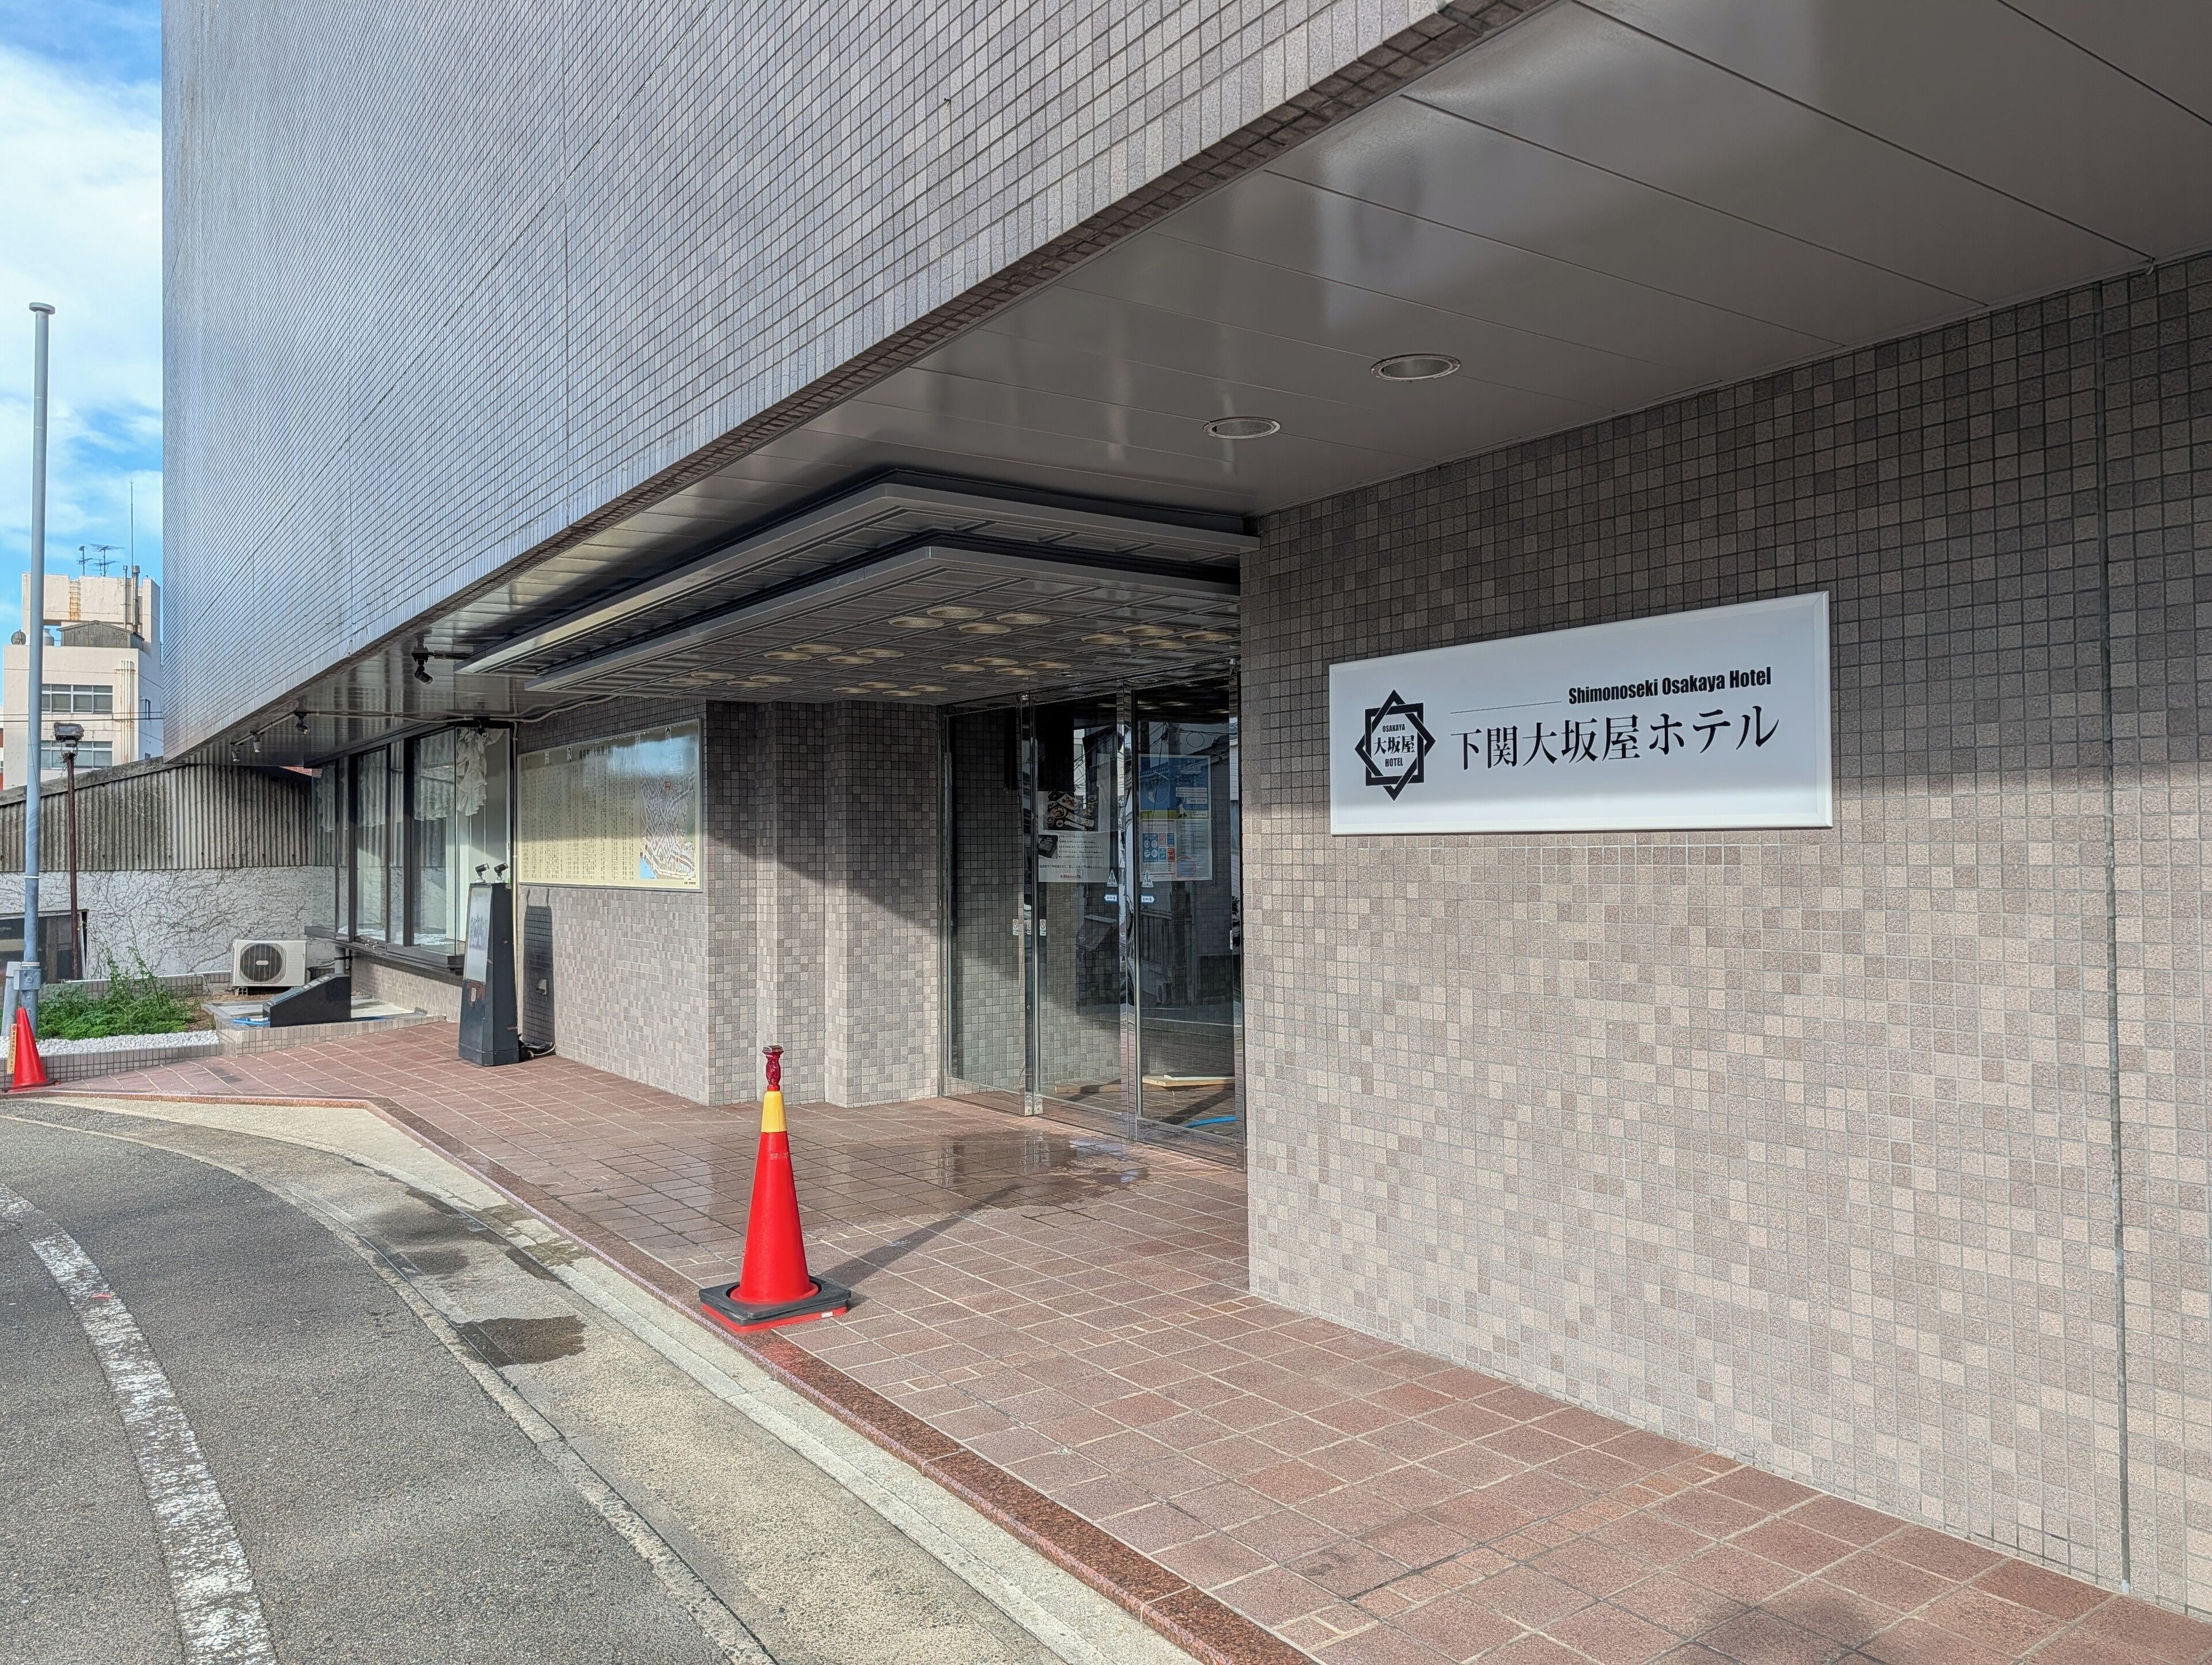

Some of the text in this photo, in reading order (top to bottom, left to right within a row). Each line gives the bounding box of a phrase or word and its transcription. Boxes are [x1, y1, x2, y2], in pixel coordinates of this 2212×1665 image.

[1569, 666, 1771, 704] Shimonoseki Osakaya Hotel
[1382, 723, 1406, 733] OSAKAYA
[1450, 706, 1779, 769] 下関大坂屋ホテル
[1373, 734, 1415, 756] 大坂屋
[1385, 757, 1403, 767] HOTEL
